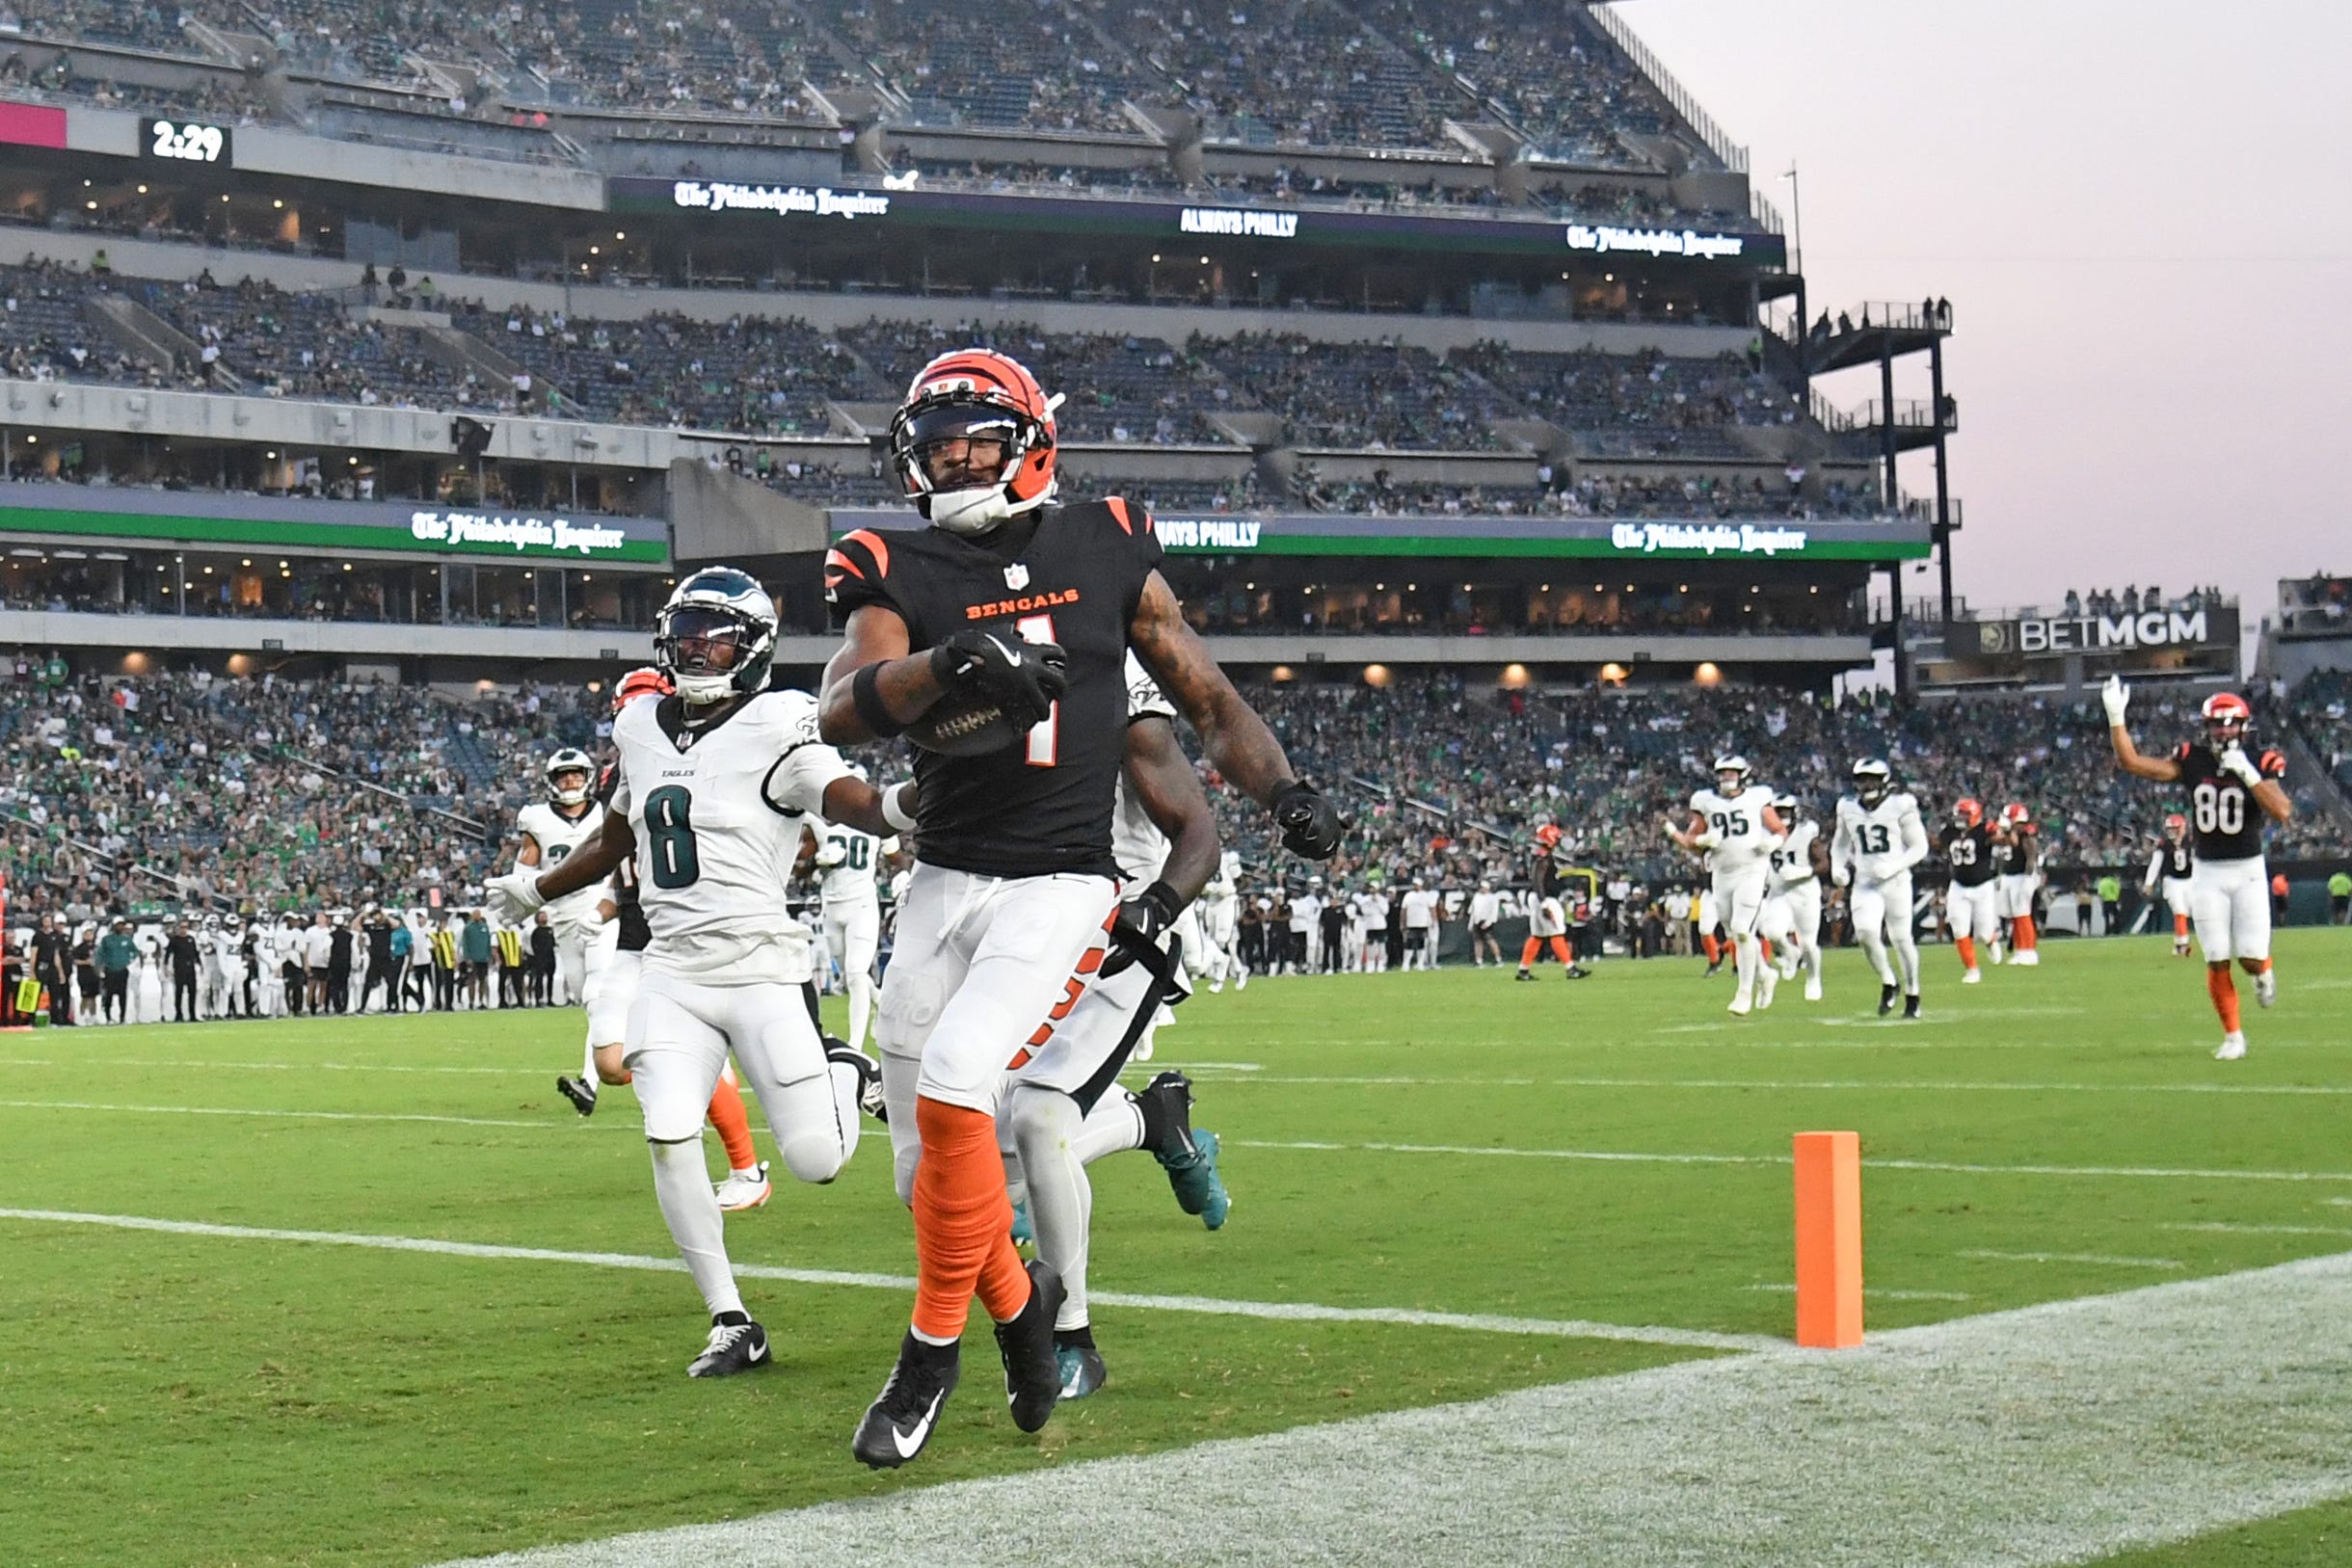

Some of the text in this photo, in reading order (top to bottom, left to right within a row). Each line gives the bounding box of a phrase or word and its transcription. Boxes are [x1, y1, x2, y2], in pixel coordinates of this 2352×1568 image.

[153, 120, 223, 162] 2:29
[675, 182, 890, 219] The Philadelphia Inquirer
[1181, 208, 1298, 237] ALWAYS PHILLY
[1567, 226, 1743, 260] The Philadelphia Inquirer
[412, 513, 625, 554] The Philadelphia Inquirer
[1154, 520, 1261, 546] WAYS PHILLY
[1612, 523, 1806, 555] The Philadelphia Inquirer
[966, 588, 1080, 620] BENGALS
[2019, 612, 2207, 651] BETMGM
[1011, 613, 1059, 767] 1
[1711, 810, 1749, 840] 95
[2194, 784, 2244, 835] 80
[644, 784, 700, 889] 8
[1857, 825, 1890, 855] 13
[1949, 837, 1976, 866] 63
